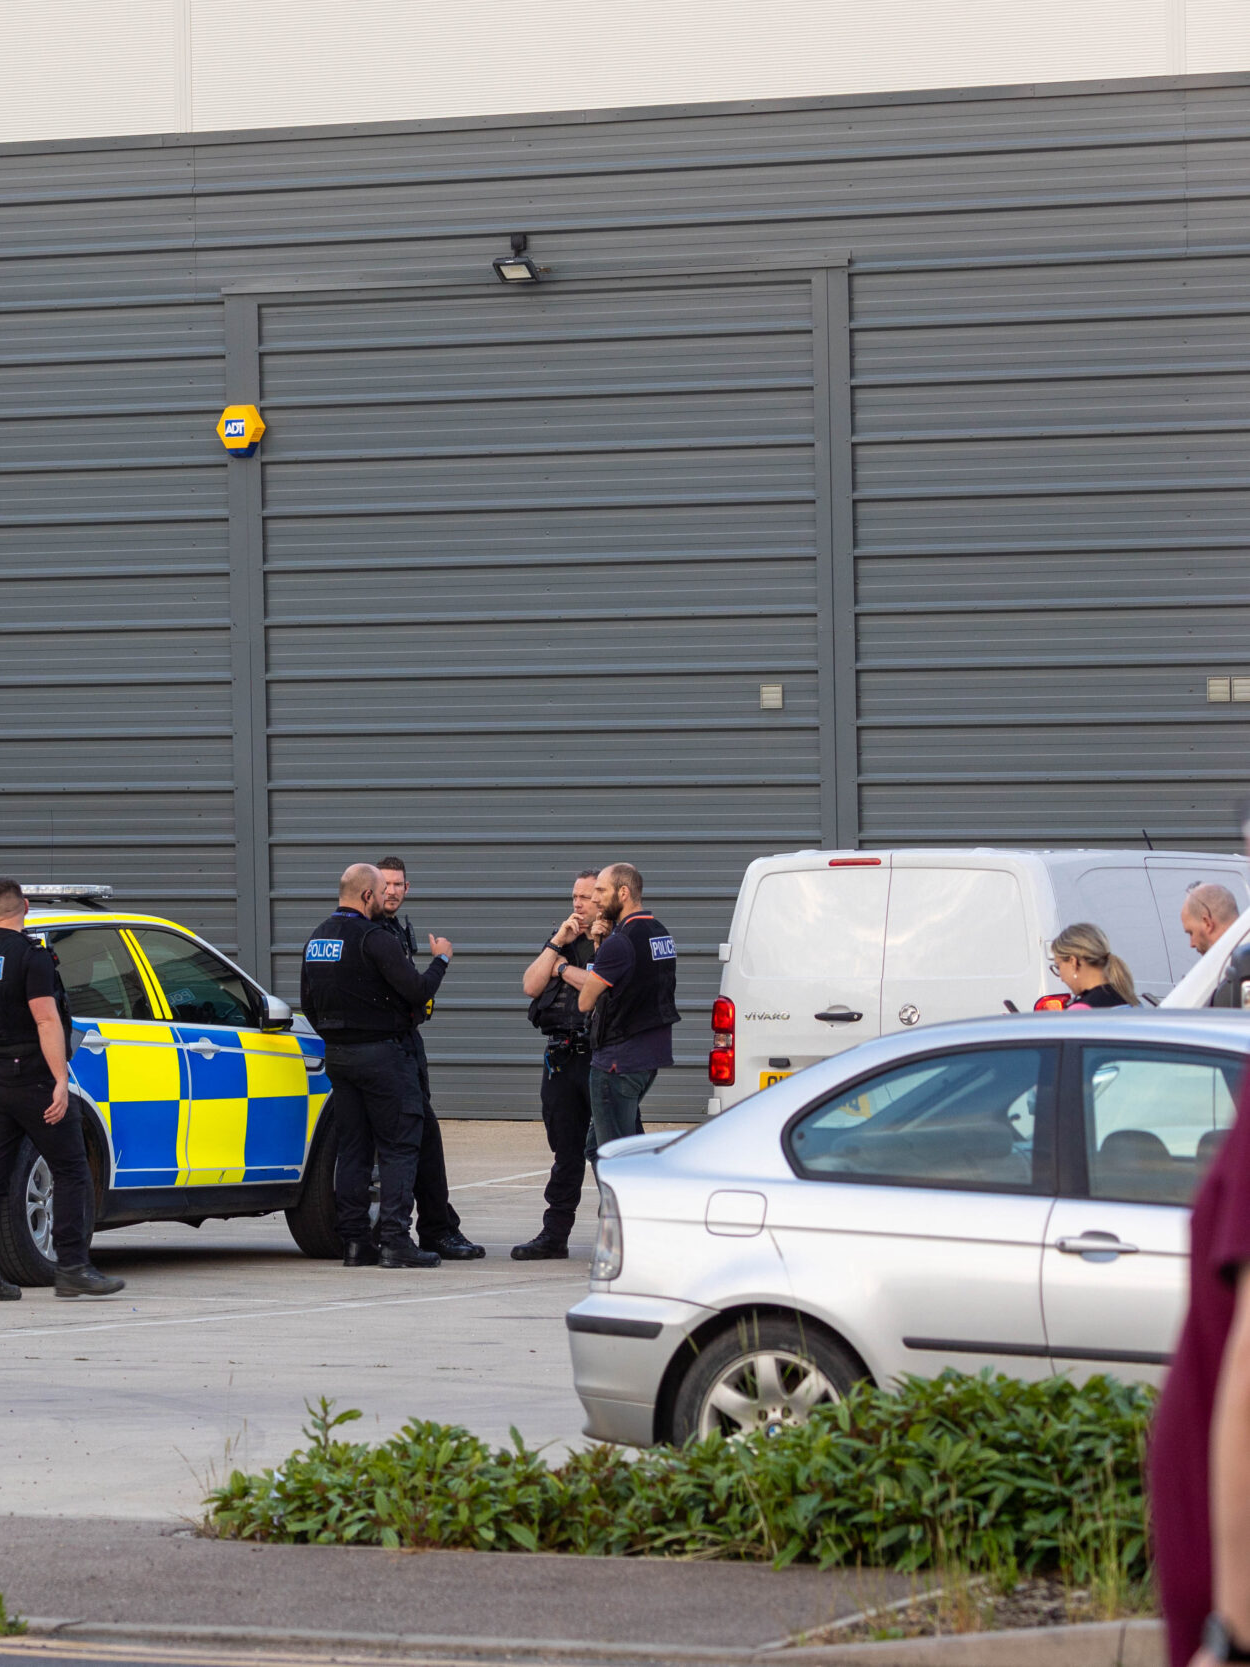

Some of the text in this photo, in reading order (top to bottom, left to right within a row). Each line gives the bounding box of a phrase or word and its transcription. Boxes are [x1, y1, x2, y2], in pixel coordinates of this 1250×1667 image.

[225, 422, 244, 435] ADT
[307, 943, 339, 958] POLICE
[652, 940, 676, 956] POLICE
[745, 1011, 791, 1020] VIVARO
